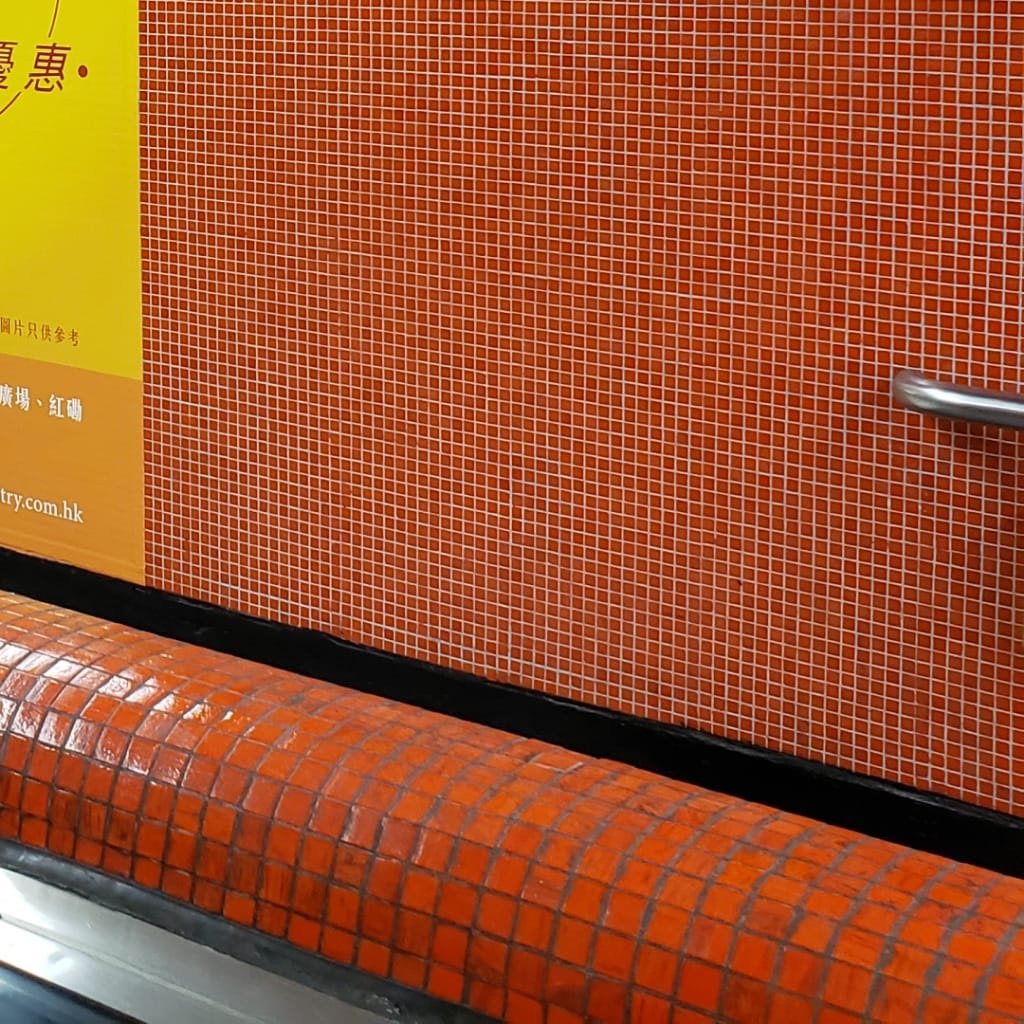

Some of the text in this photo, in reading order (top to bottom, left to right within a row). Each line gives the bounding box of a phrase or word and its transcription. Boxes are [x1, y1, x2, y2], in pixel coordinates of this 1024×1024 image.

[0, 316, 80, 347] 圖片只供參考
